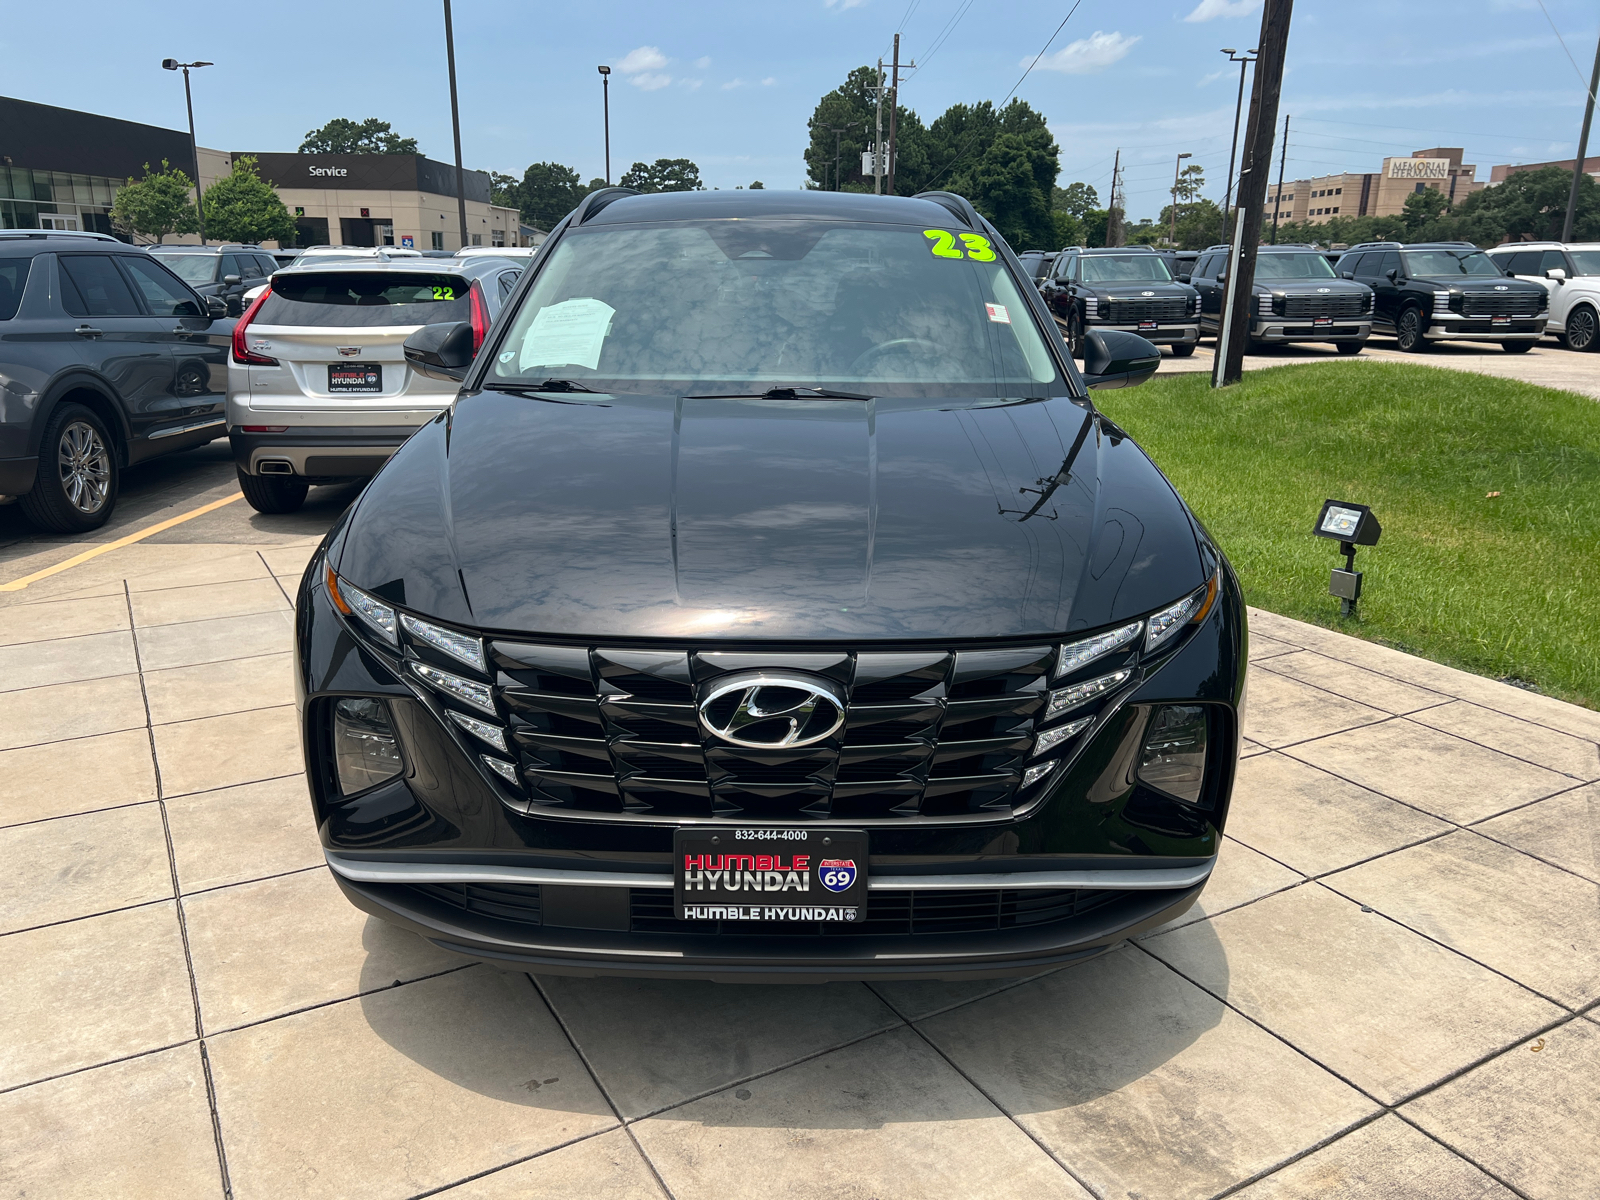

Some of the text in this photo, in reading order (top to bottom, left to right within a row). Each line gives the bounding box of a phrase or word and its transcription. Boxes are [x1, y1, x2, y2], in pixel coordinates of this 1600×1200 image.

[308, 165, 348, 177] Service
[1393, 161, 1447, 171] MEMORIAL
[1391, 169, 1445, 178] HERMANN
[923, 229, 997, 262] 23
[432, 286, 455, 300] 22
[735, 830, 808, 841] 832-644-4000
[684, 854, 810, 871] HUMBLE
[684, 870, 810, 891] HYUNDAI
[824, 871, 850, 886] 69
[684, 907, 761, 920] HUMBLE
[764, 907, 844, 921] HYUNDAI
